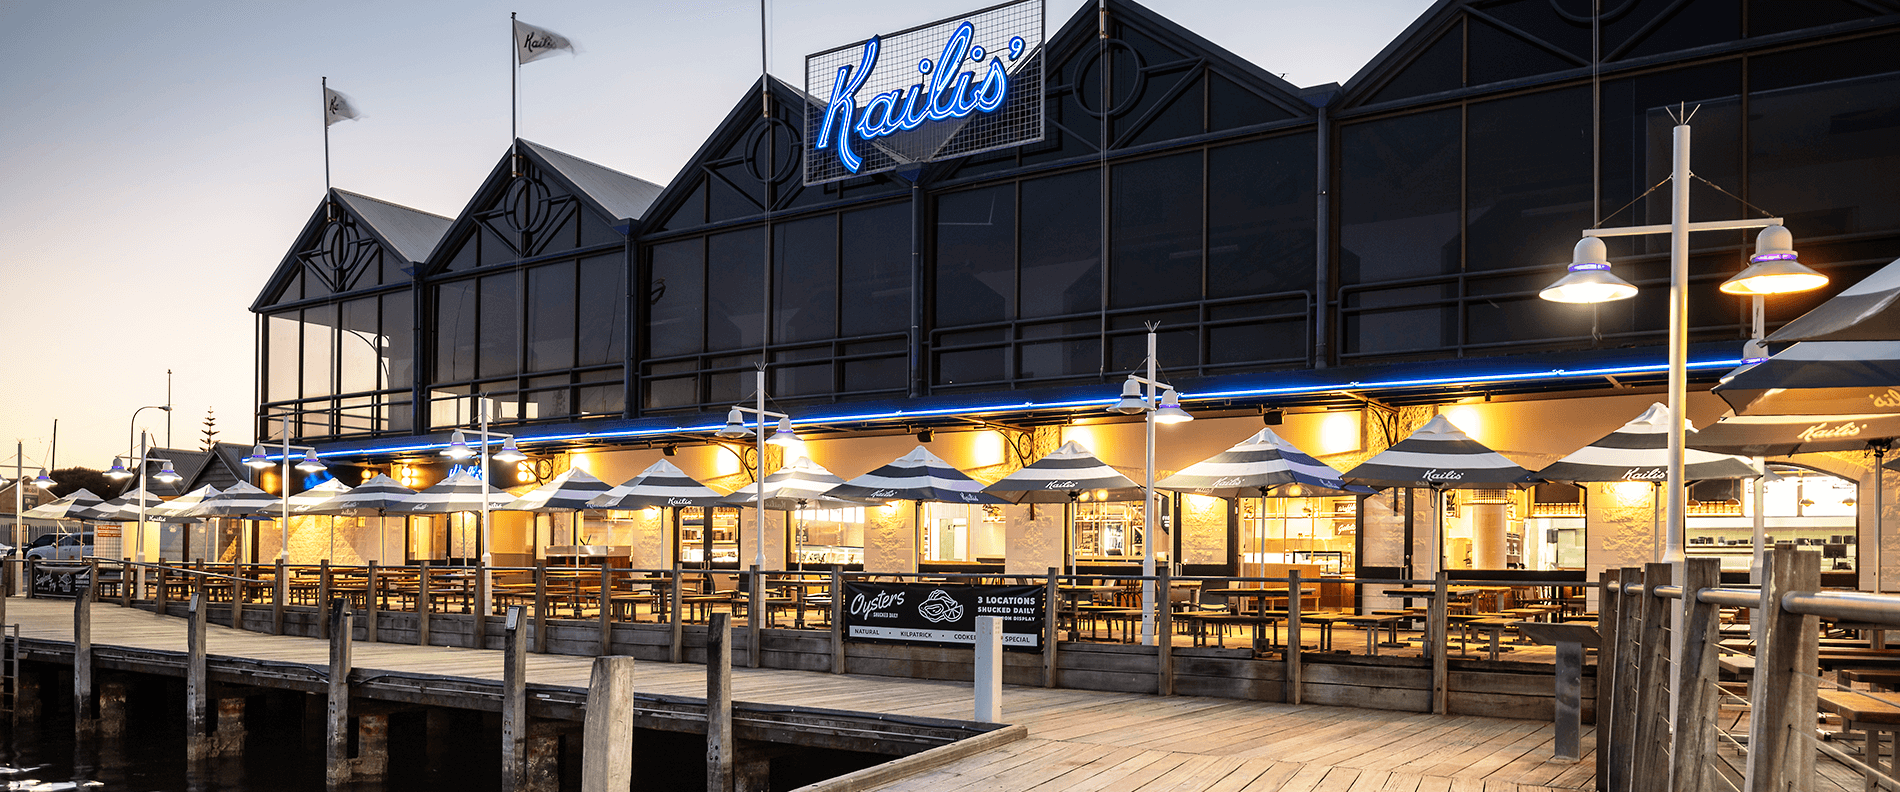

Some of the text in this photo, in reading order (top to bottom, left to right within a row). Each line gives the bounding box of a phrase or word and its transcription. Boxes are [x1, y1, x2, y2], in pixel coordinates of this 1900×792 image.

[1797, 421, 1867, 442] Kailis'
[850, 590, 906, 620] Oysters
[977, 596, 1036, 605] 3 LOCATIONS
[977, 606, 1036, 615] SHUCKED DAILY
[1004, 635, 1030, 643] SPECIAL
